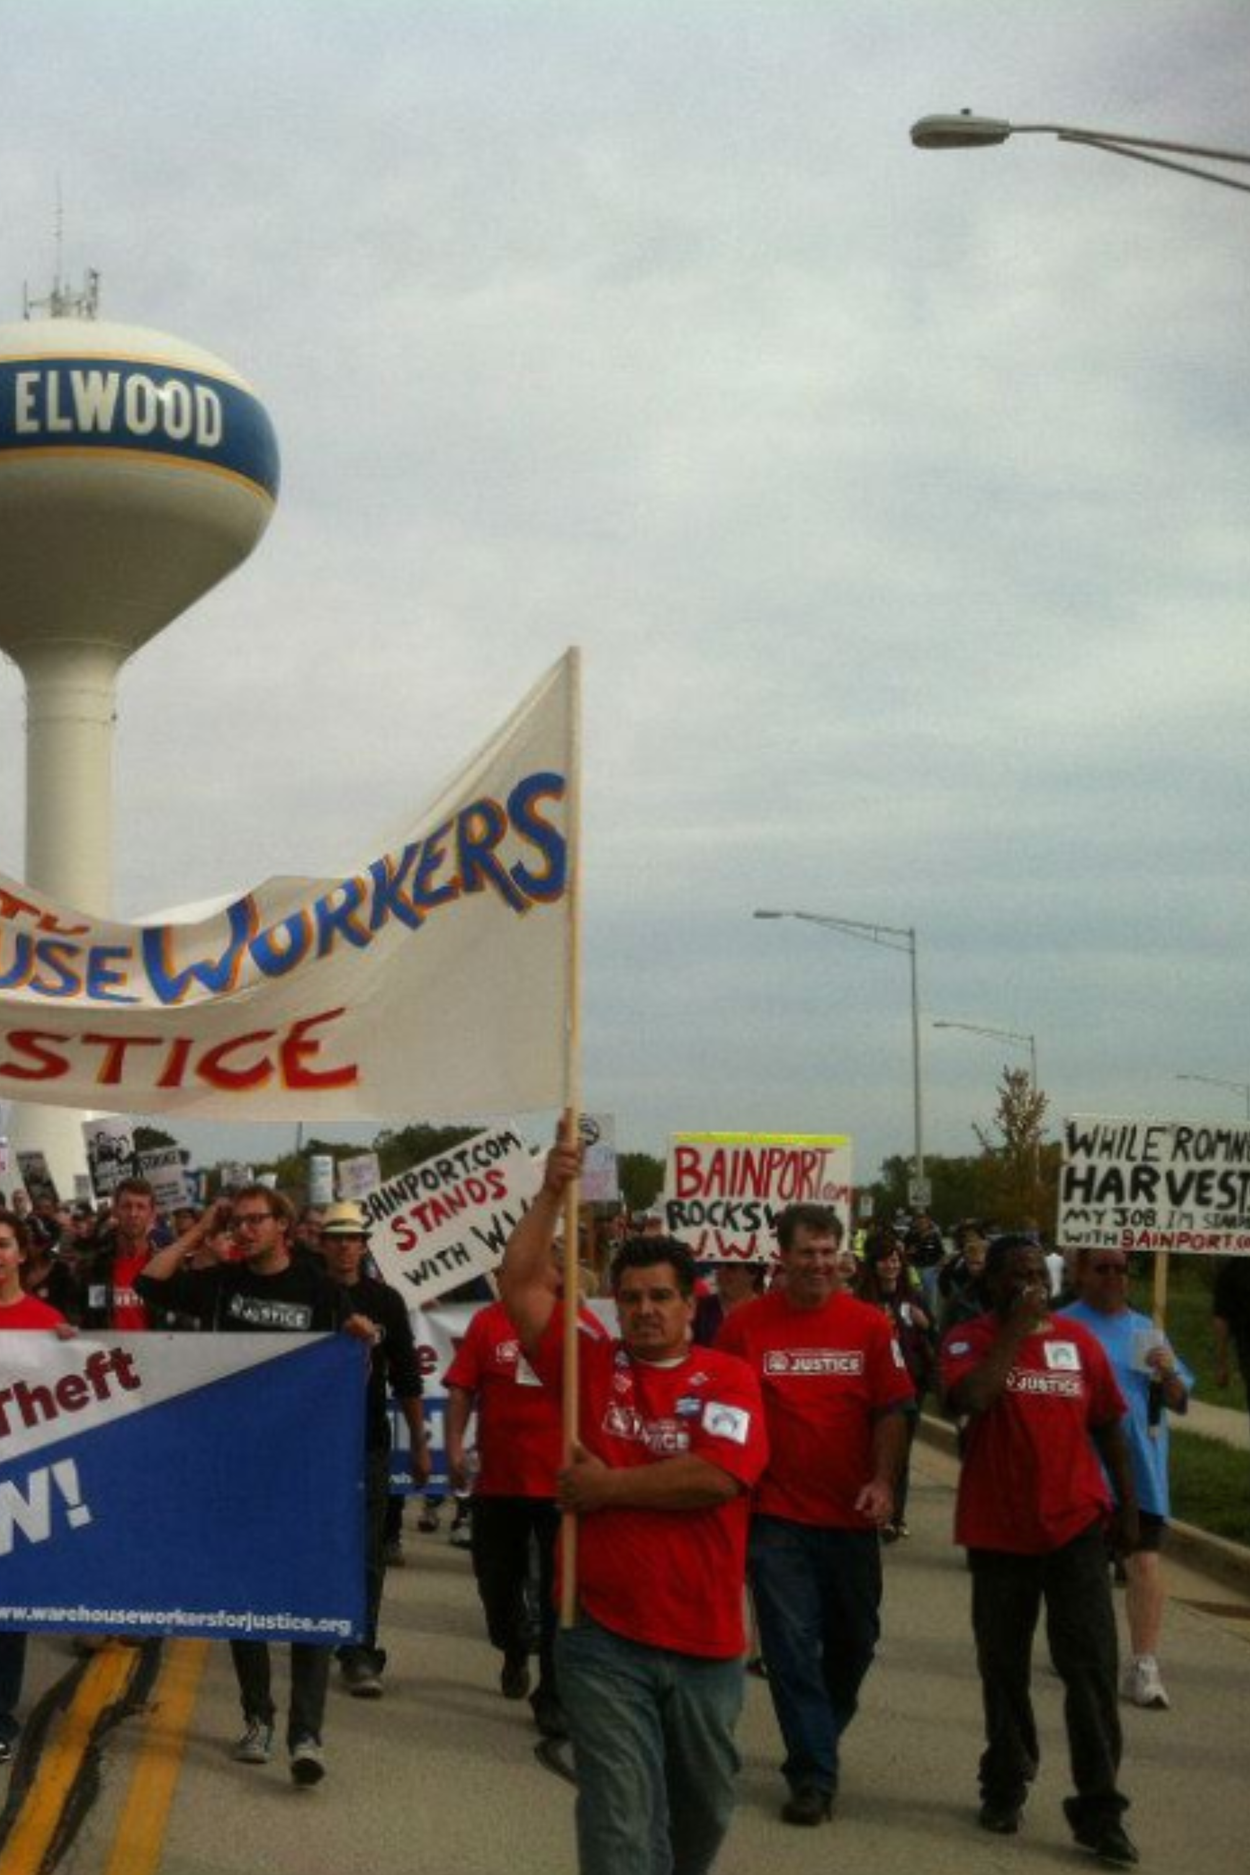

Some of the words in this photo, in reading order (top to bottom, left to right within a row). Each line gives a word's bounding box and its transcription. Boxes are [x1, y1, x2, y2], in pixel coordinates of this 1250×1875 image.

[15, 369, 223, 448] ELWOOD
[142, 771, 567, 1005] WORKERS
[1064, 1120, 1167, 1162] WHILE
[391, 1169, 508, 1252] STANDS
[1063, 1164, 1250, 1214] HARVEST
[666, 1200, 762, 1232] ROCKS
[1063, 1208, 1106, 1224] MY
[1064, 1230, 1118, 1245] WITH
[403, 1242, 471, 1286] WITH
[790, 1357, 860, 1373] JUSTICE
